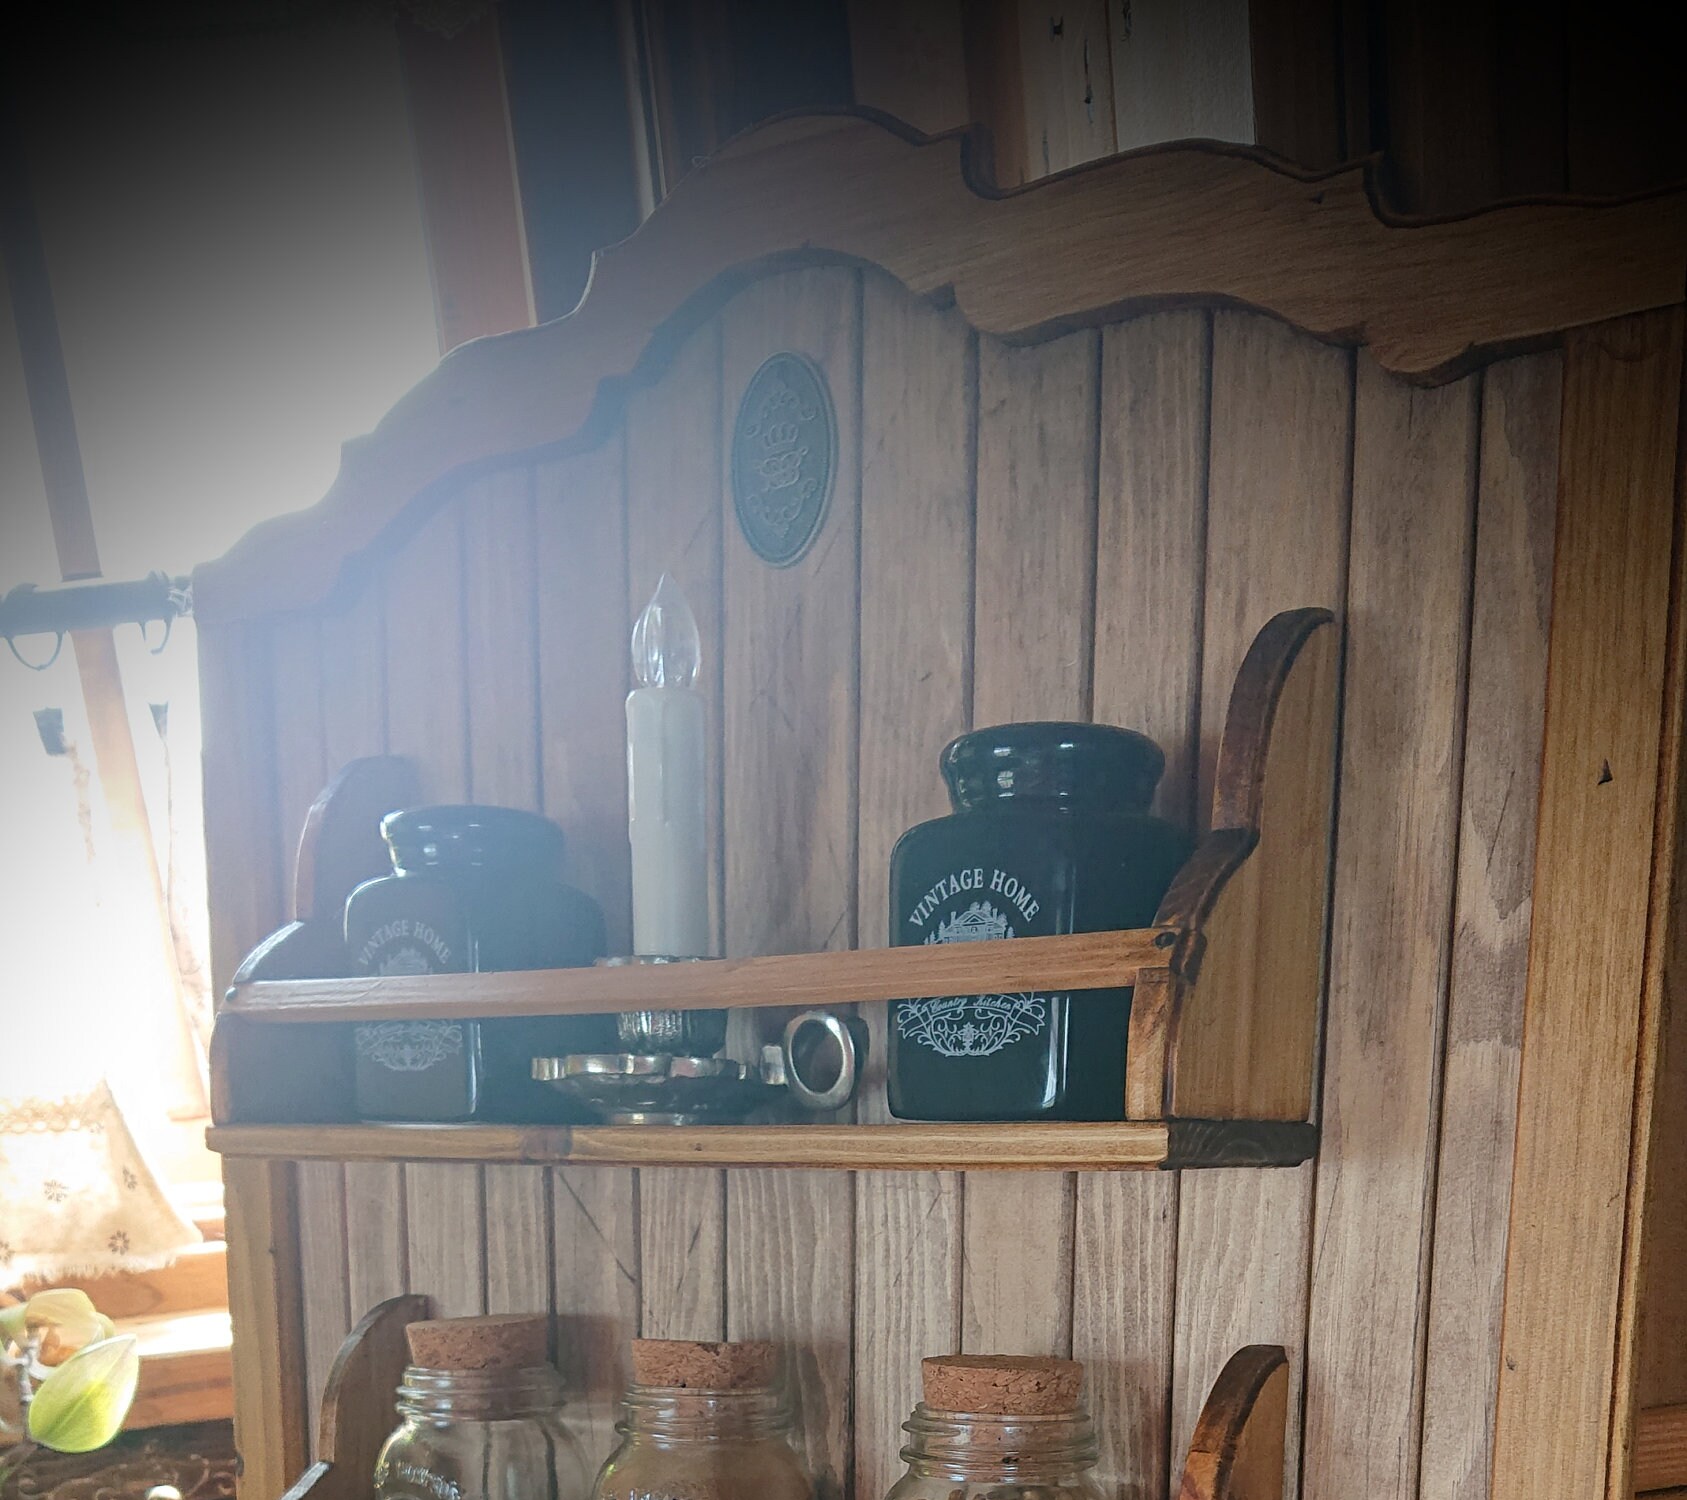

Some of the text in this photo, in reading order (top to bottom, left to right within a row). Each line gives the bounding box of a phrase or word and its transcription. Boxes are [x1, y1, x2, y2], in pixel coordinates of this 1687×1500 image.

[909, 868, 1040, 927] VINTAGE HOME
[358, 920, 451, 966] VINTAGE HOME
